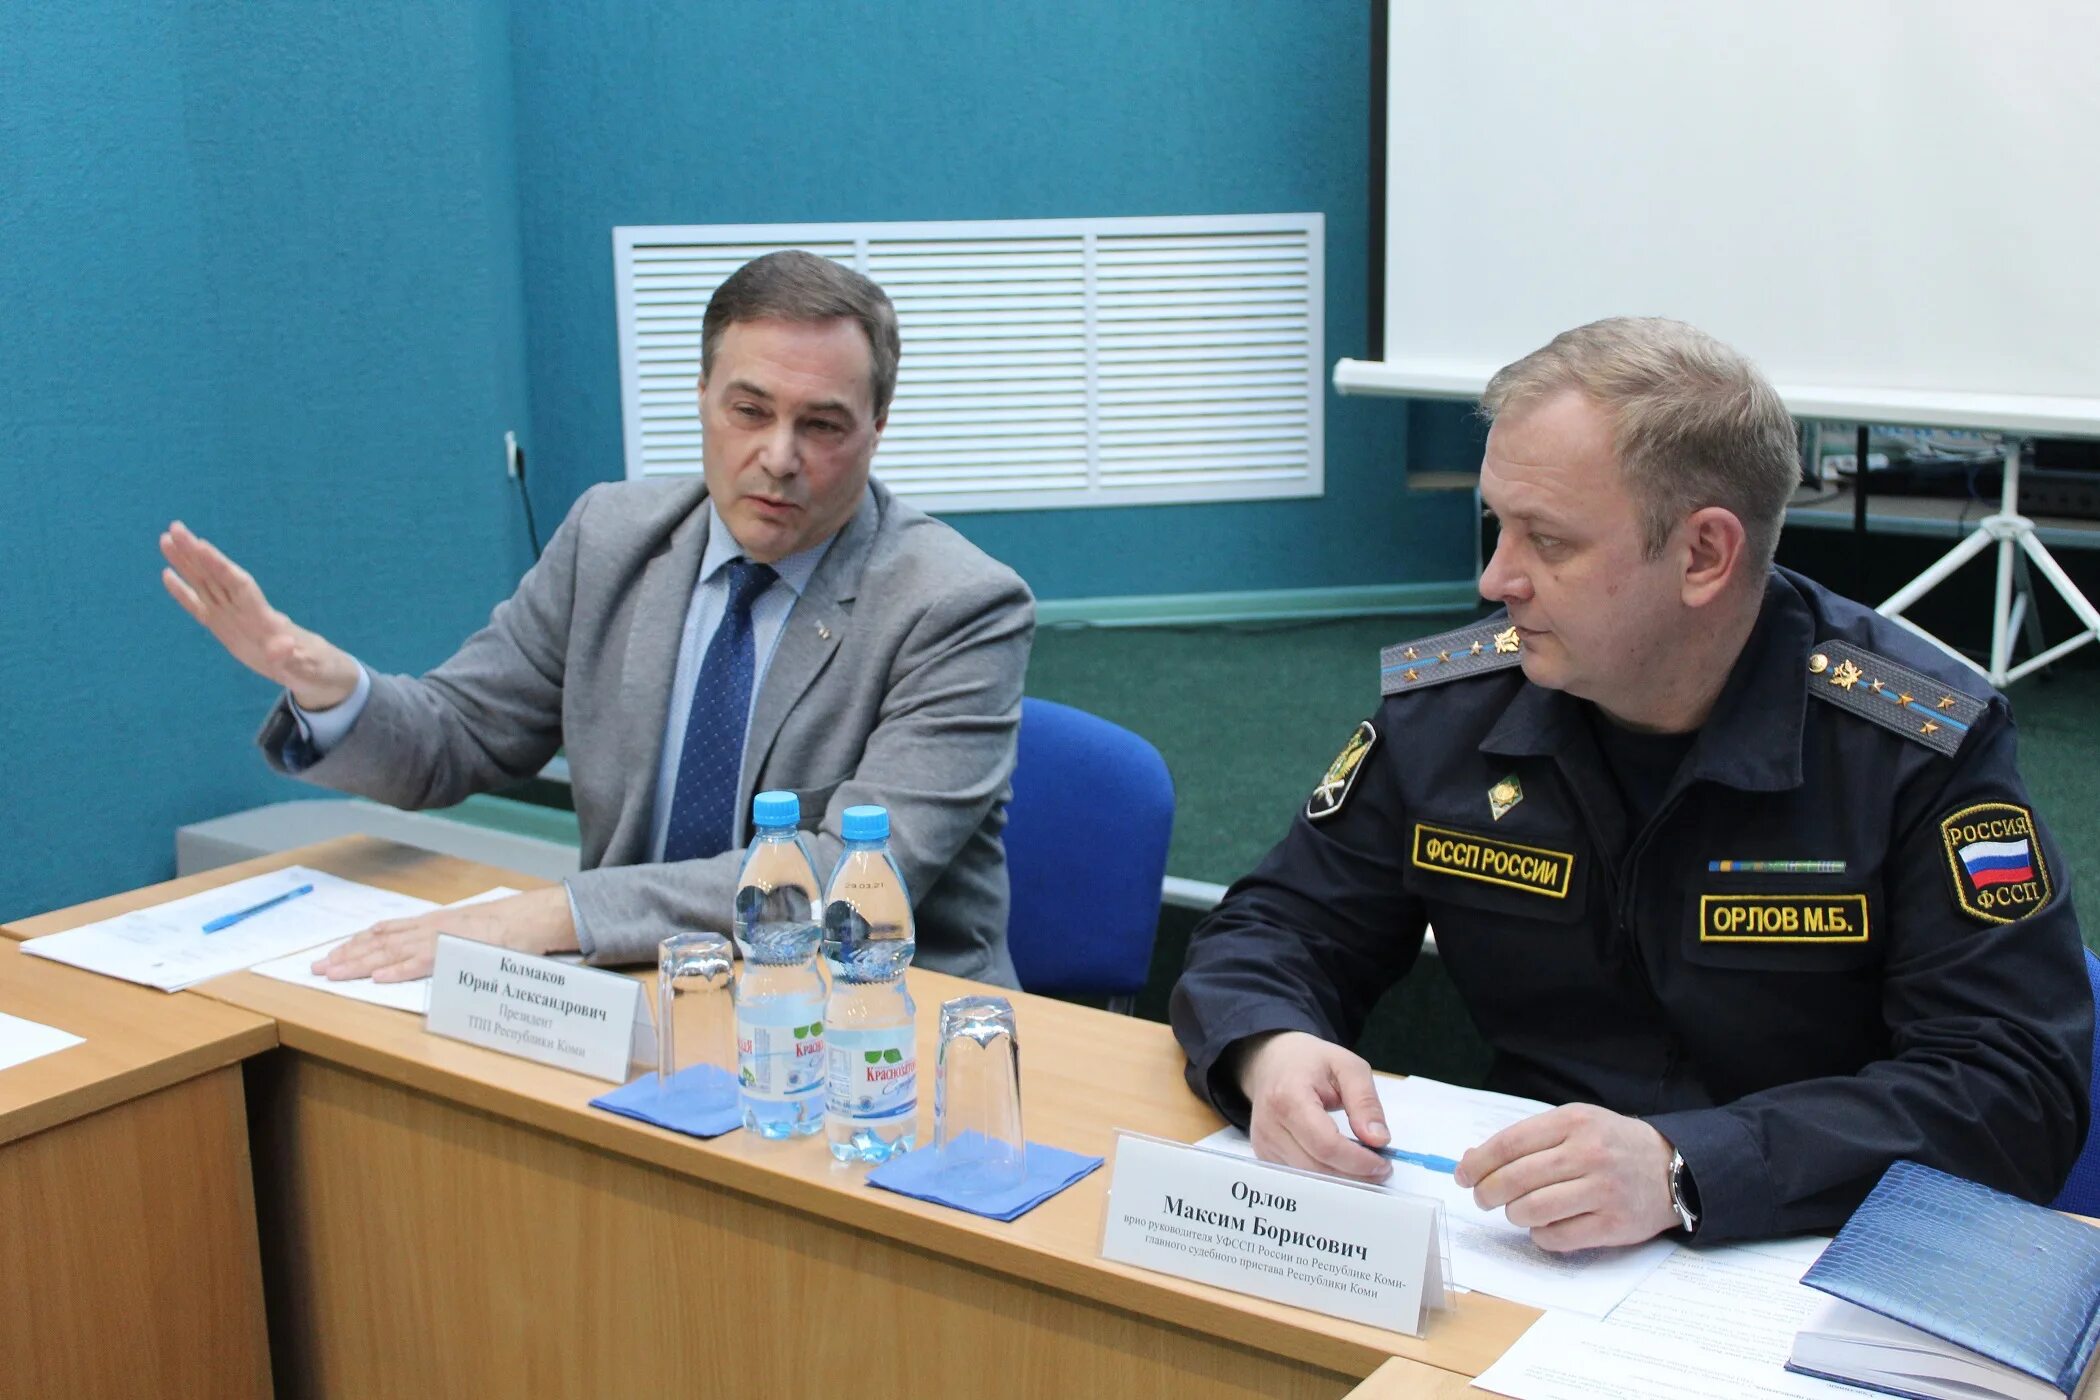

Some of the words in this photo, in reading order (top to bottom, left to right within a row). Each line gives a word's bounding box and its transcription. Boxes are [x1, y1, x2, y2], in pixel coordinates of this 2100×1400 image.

[1948, 817, 2030, 846] РОССИЯ
[1426, 838, 1480, 869] ФССП
[1481, 848, 1558, 886] РОССИИ
[1977, 882, 2040, 909] ФССП
[1714, 906, 1799, 933] ОРЛОВ
[1804, 906, 1854, 933] М.Б.
[500, 956, 566, 986] Колмаков
[458, 970, 498, 993] Юрий
[502, 983, 607, 1022] Александрович
[499, 1003, 553, 1029] Президент
[468, 1014, 491, 1033] ТПП
[493, 1022, 555, 1049] Республики
[557, 1039, 586, 1058] Коми
[1231, 1180, 1298, 1213] Орлов
[1163, 1195, 1246, 1232] Максим
[1252, 1216, 1369, 1262] Борисович
[1124, 1214, 1147, 1231] врио
[1148, 1219, 1213, 1245] руководителя
[1216, 1235, 1256, 1254] УФССП
[1258, 1244, 1294, 1263] России
[1296, 1255, 1309, 1266] по
[1311, 1257, 1372, 1283] Республике
[1373, 1272, 1407, 1290] Коми-
[1145, 1235, 1187, 1253] главного
[1188, 1245, 1238, 1266] судебного
[1239, 1259, 1285, 1277] пристава
[1286, 1267, 1348, 1293] Республики
[1349, 1282, 1379, 1299] Коми
